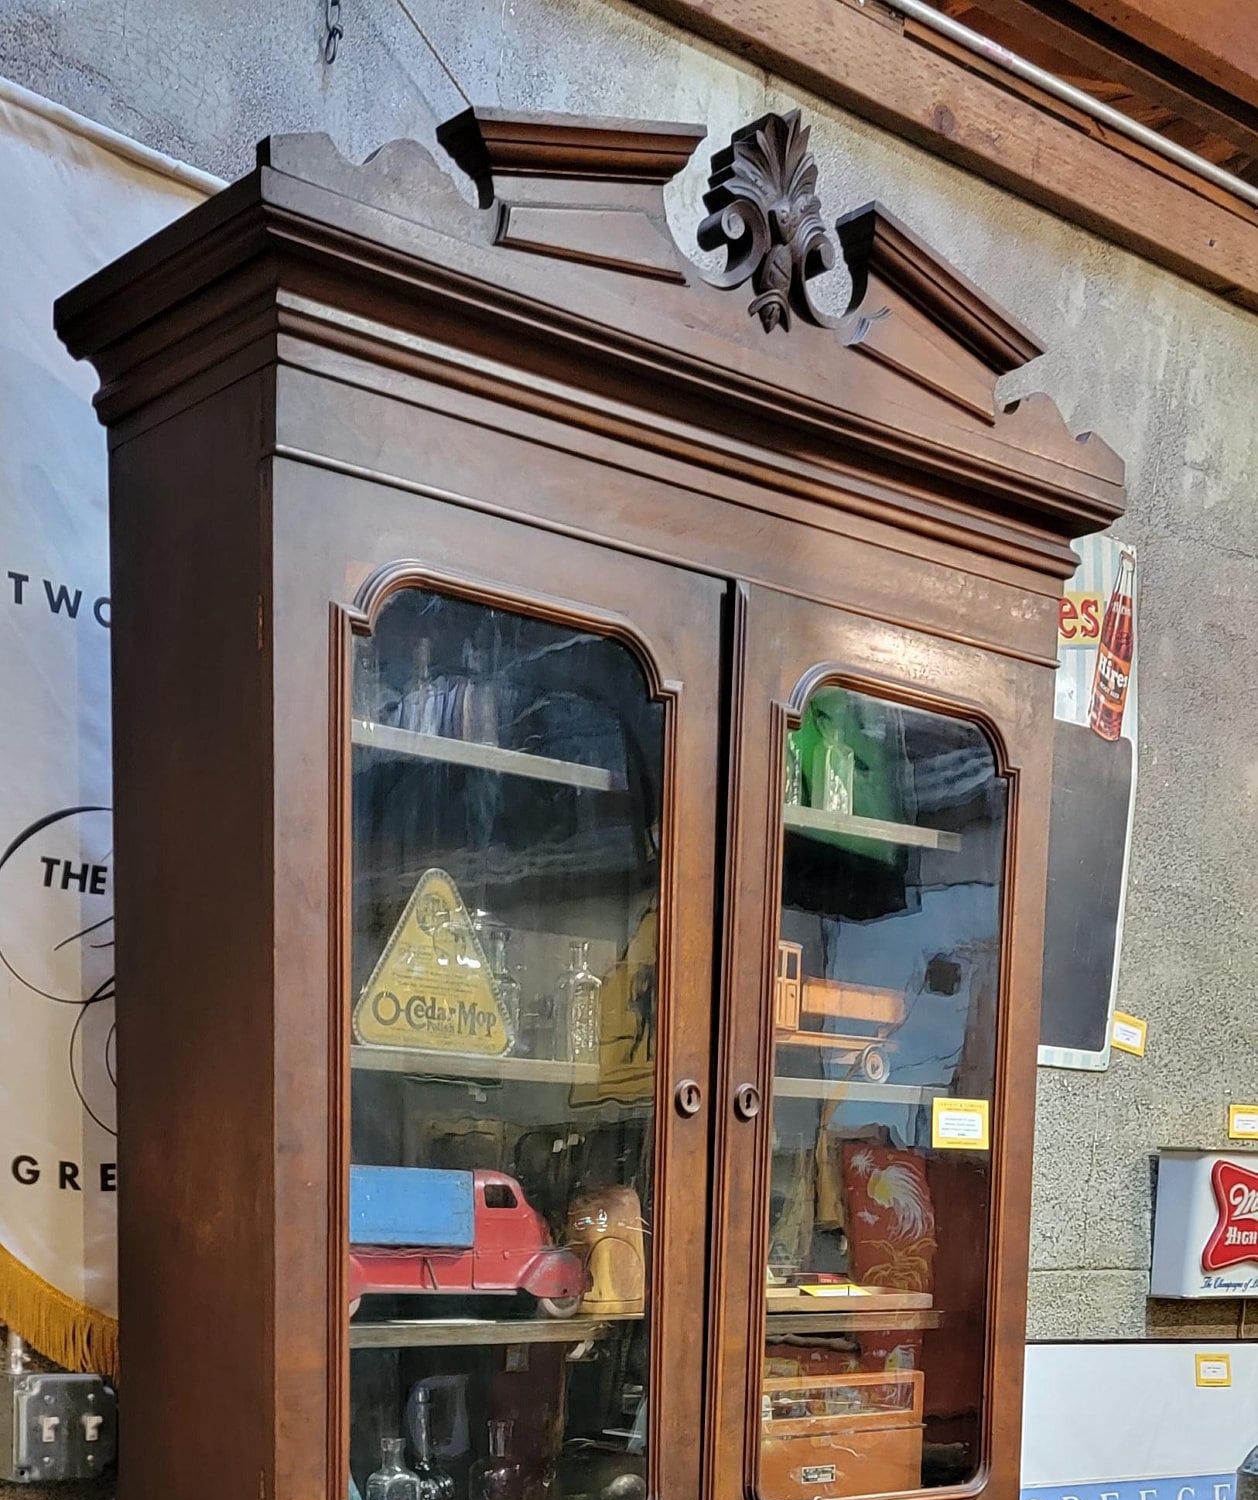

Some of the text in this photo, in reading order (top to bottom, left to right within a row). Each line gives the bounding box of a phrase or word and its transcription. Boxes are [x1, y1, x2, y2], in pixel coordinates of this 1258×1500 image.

[1058, 598, 1099, 638] es
[40, 856, 108, 895] THE
[372, 991, 497, 1038] O-Cedar Mop
[11, 1155, 116, 1192] GRE
